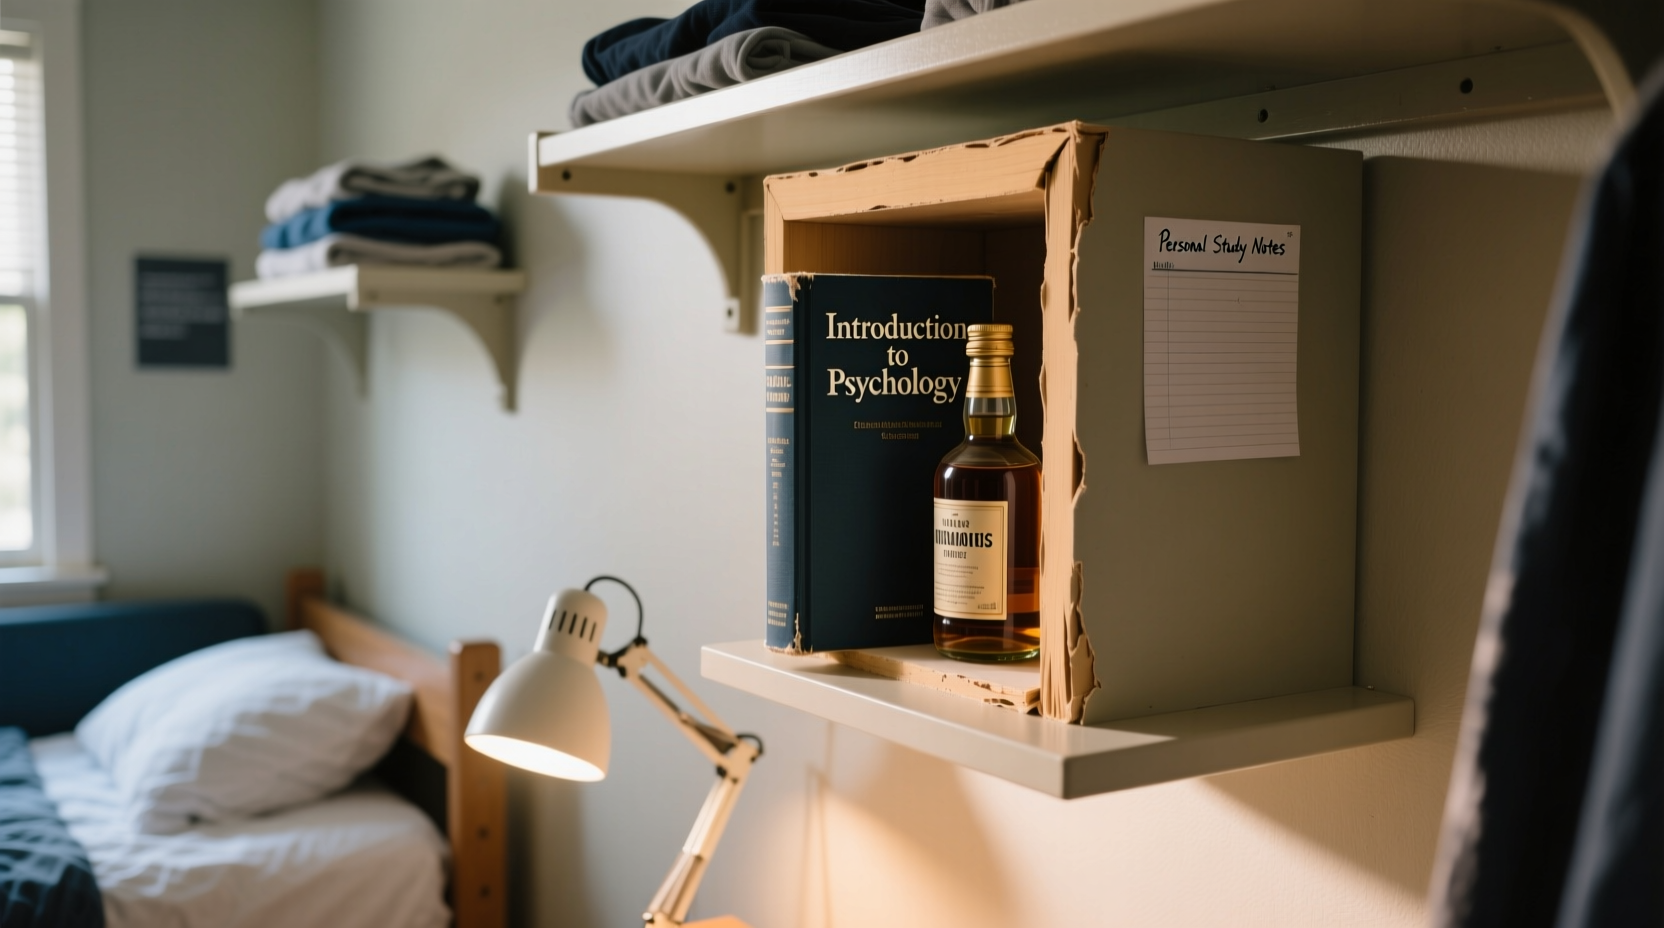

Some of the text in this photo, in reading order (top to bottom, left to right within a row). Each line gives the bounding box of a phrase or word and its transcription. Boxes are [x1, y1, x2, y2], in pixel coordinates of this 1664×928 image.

[1159, 228, 1286, 264] Personal Study Notes
[825, 312, 967, 340] Introduction
[886, 345, 909, 367] to
[826, 366, 962, 404] Psychology
